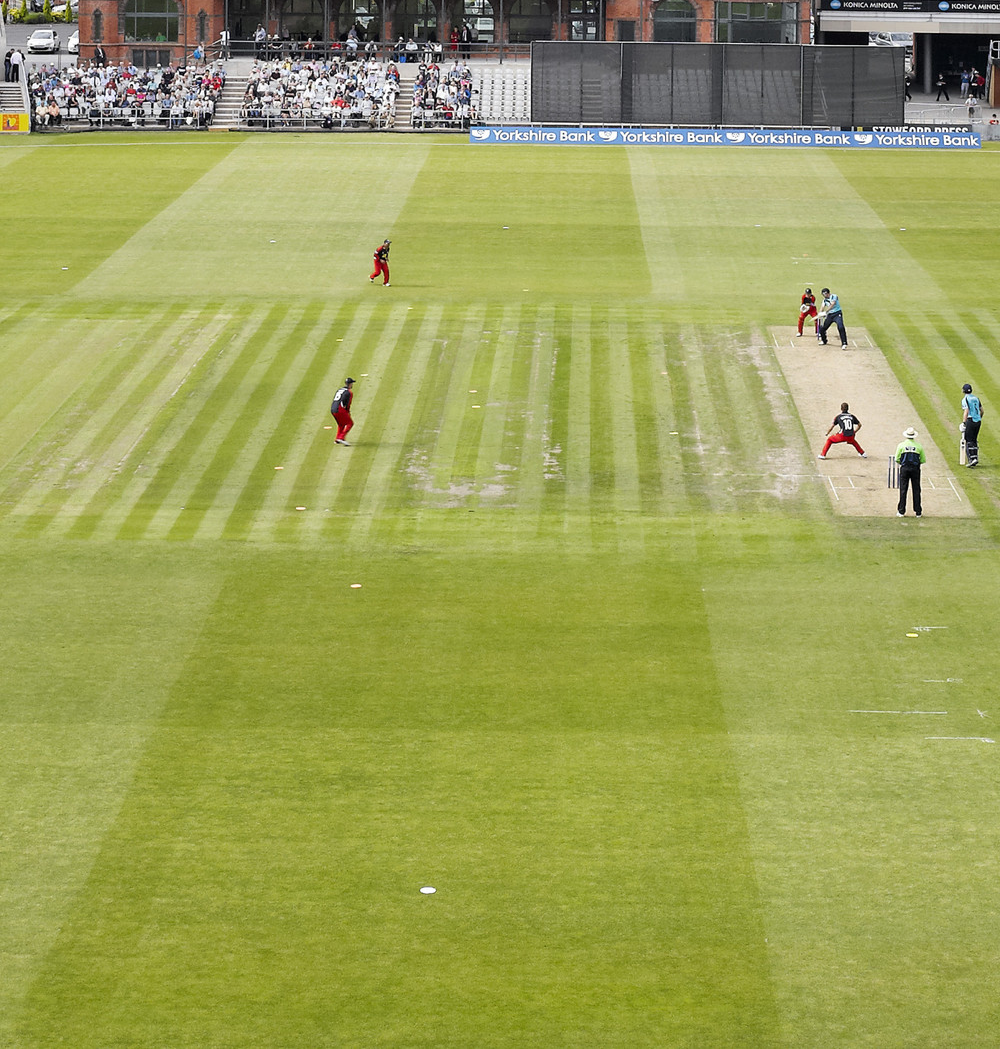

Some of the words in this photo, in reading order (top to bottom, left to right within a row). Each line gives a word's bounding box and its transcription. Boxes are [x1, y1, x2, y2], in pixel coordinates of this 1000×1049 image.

[843, 1, 868, 9] KONICA
[493, 129, 556, 141] Yorkshire
[560, 130, 595, 142] Bank
[620, 130, 683, 143] Yorkshire
[687, 131, 722, 143] Bank
[748, 132, 811, 144] Yorkshire
[815, 133, 850, 145] Bank
[875, 134, 939, 146] Yorkshire
[943, 134, 979, 147] Bank
[843, 419, 852, 430] 10
